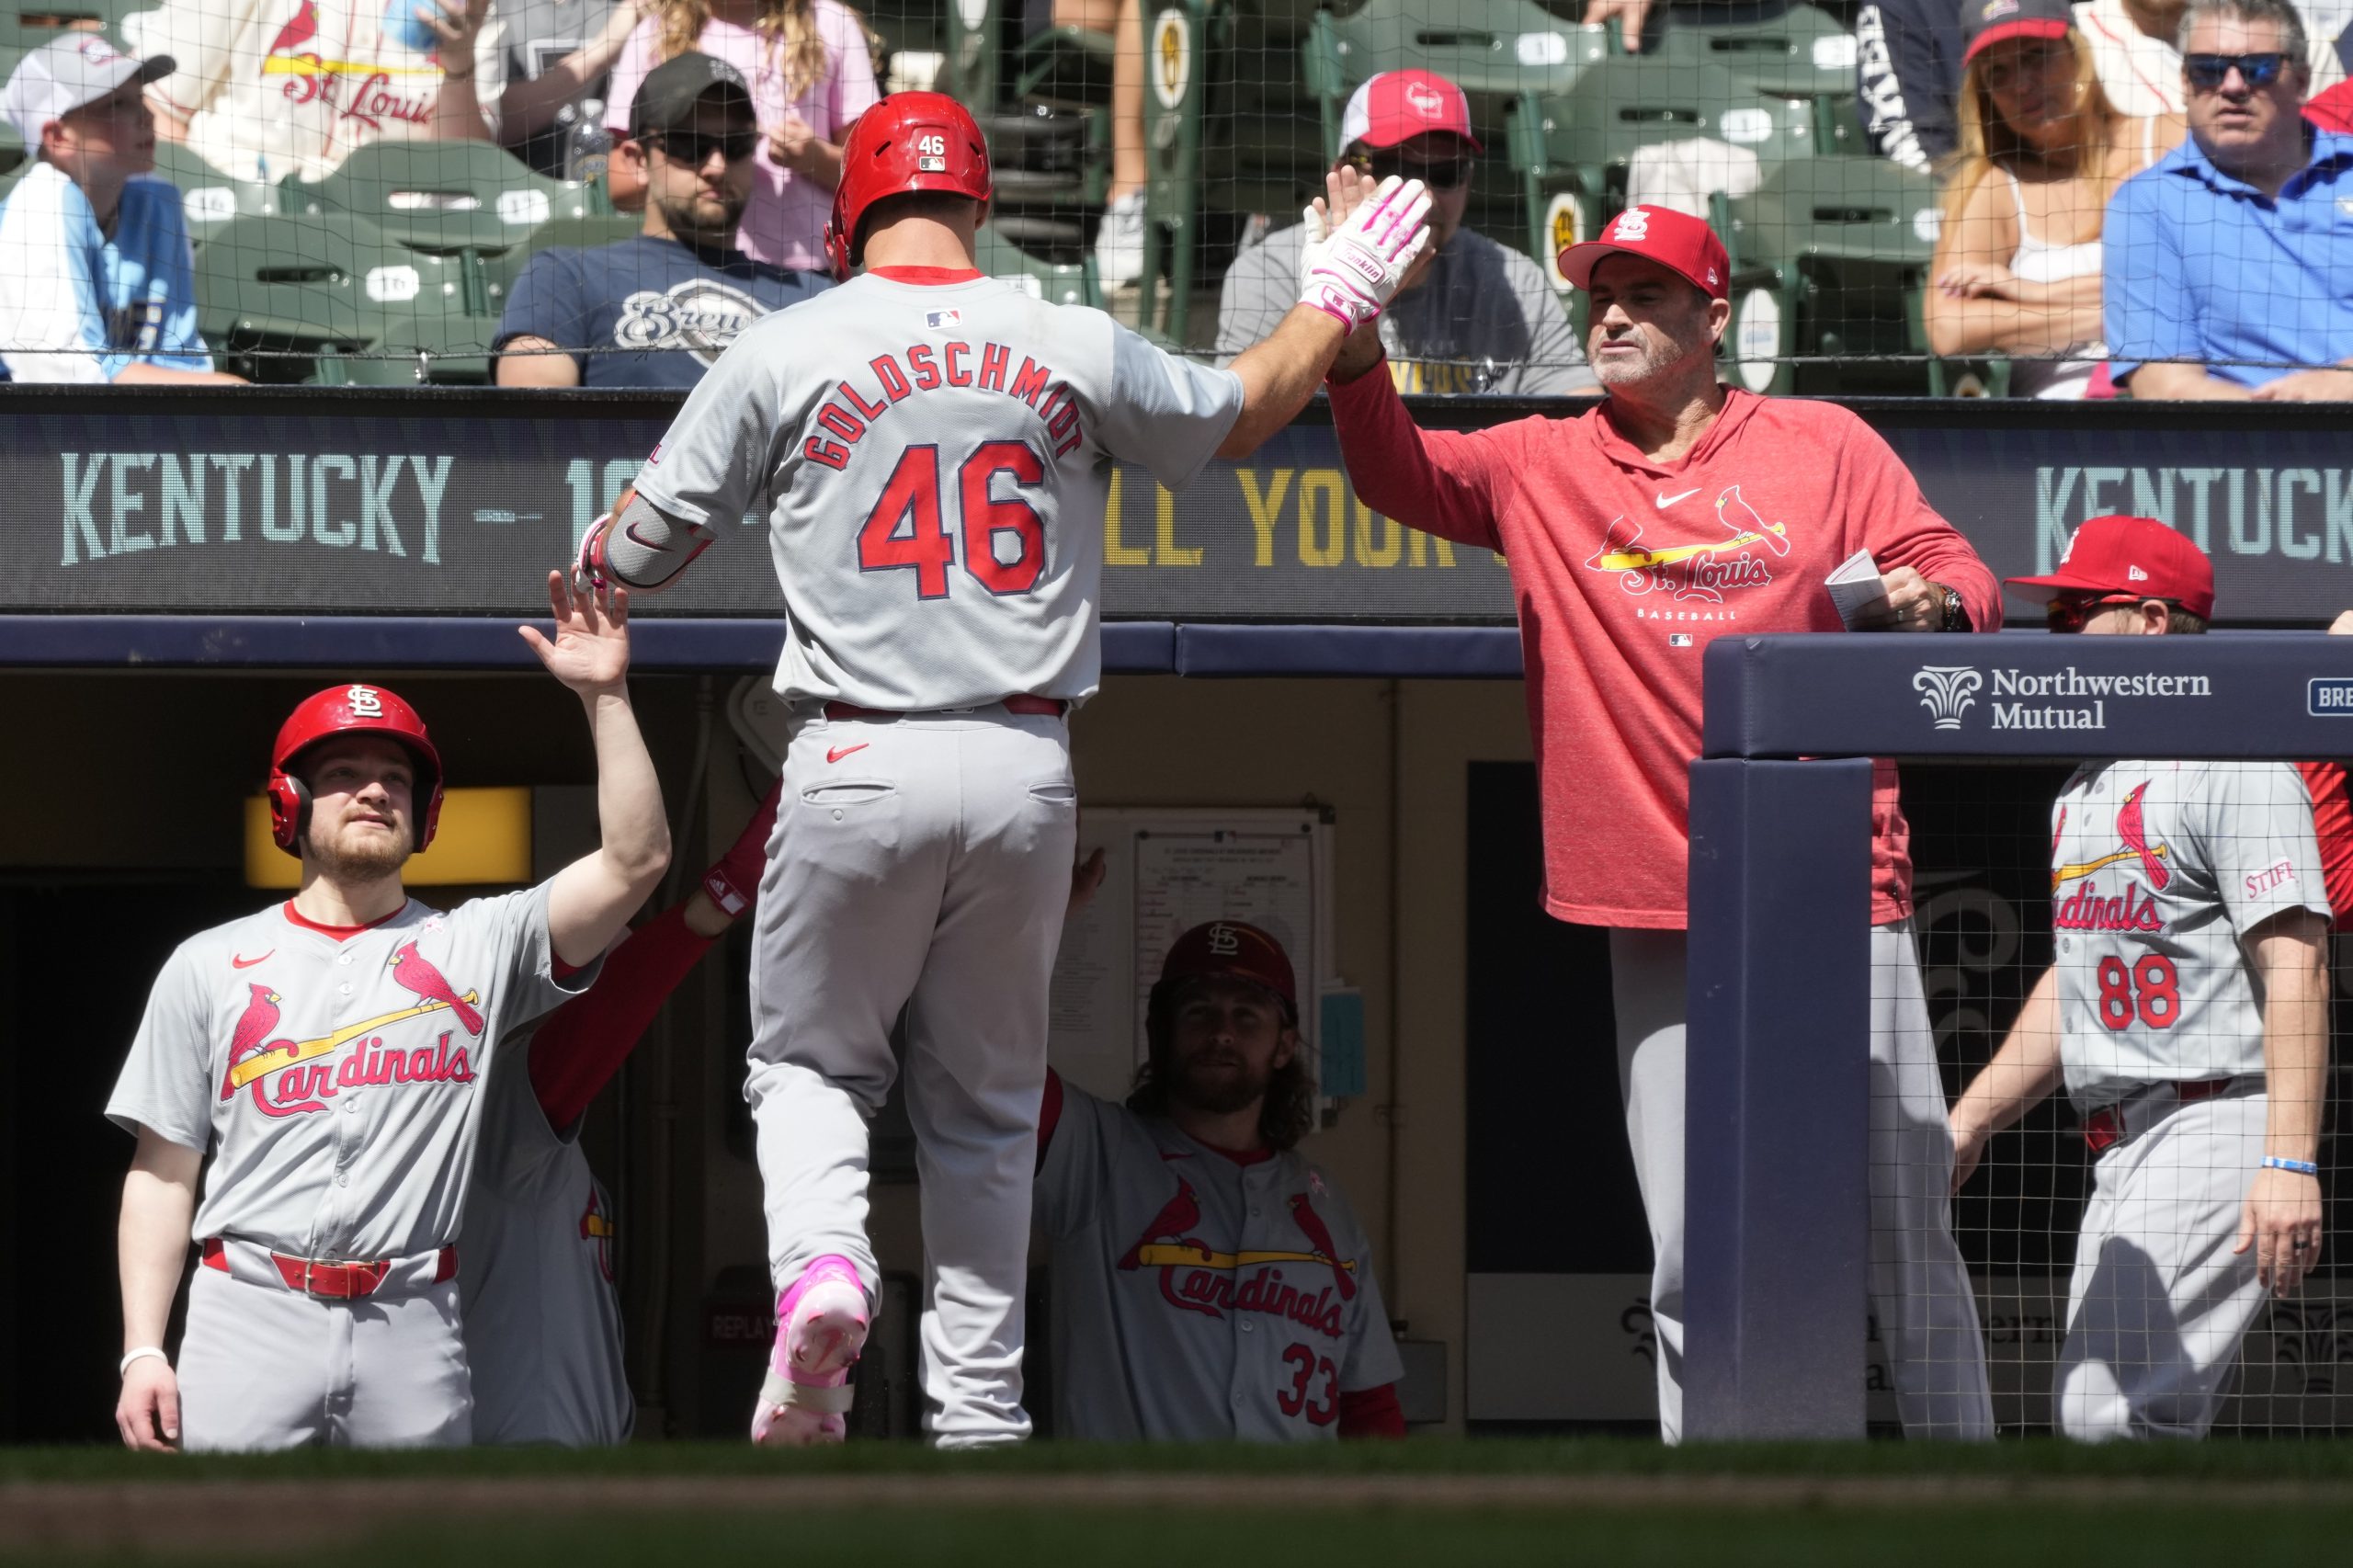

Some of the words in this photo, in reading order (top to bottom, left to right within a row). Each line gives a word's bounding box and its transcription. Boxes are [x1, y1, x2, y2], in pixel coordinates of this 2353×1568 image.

[919, 135, 944, 155] 46
[803, 341, 1083, 472] GOLDSCHMIDT
[61, 452, 455, 566] KENTUCKY
[857, 439, 1046, 601] 46
[1637, 608, 1737, 621] BASEBALL
[1674, 550, 1773, 604] Louis
[1991, 666, 2212, 697] Northwestern
[1991, 700, 2107, 730] Mutual
[2051, 881, 2166, 934] dinals
[2097, 952, 2182, 1031] 88
[250, 1028, 478, 1119] Cardinals
[1158, 1237, 1347, 1340] Cardinals
[1277, 1341, 1339, 1427] 33
